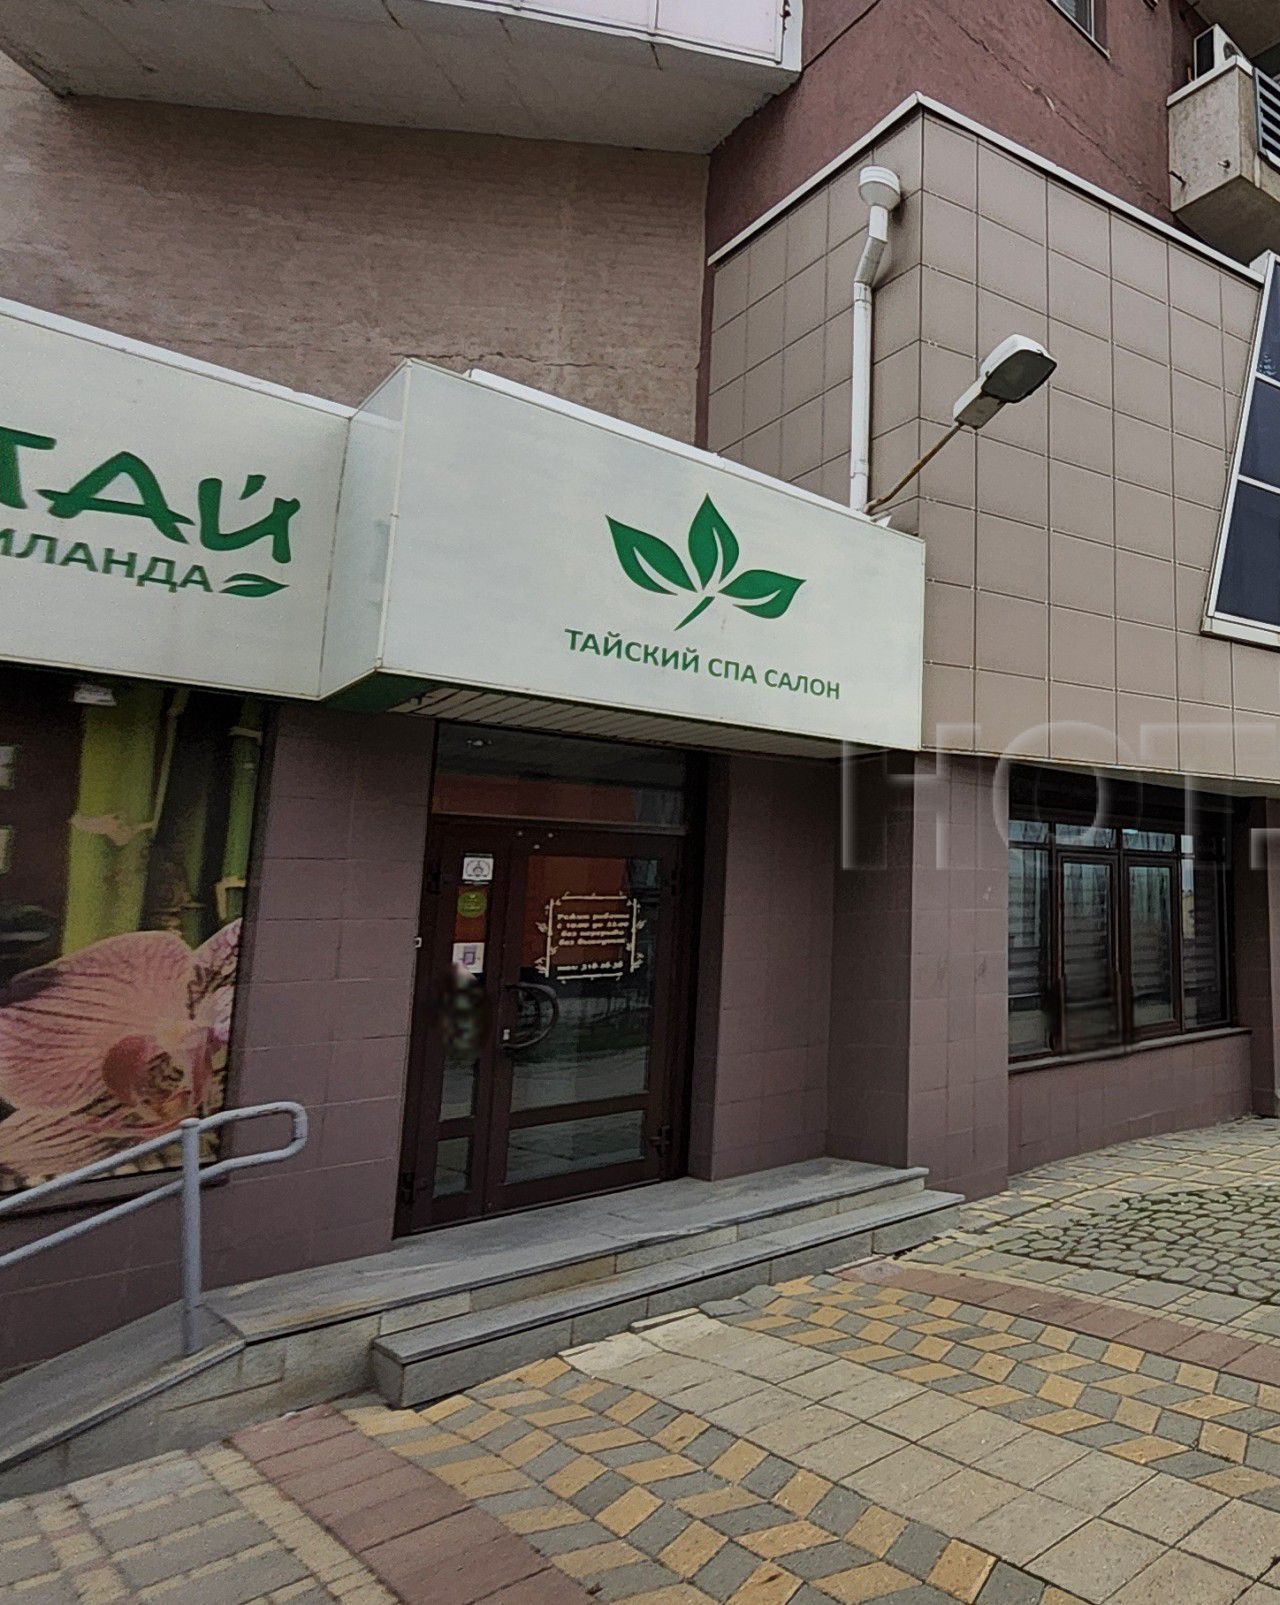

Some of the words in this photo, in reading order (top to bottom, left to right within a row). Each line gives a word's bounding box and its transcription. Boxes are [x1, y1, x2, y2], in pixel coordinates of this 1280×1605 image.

[564, 628, 699, 673] ТАЙСКИЙ
[708, 658, 757, 684] СПА
[764, 669, 840, 699] САЛОН
